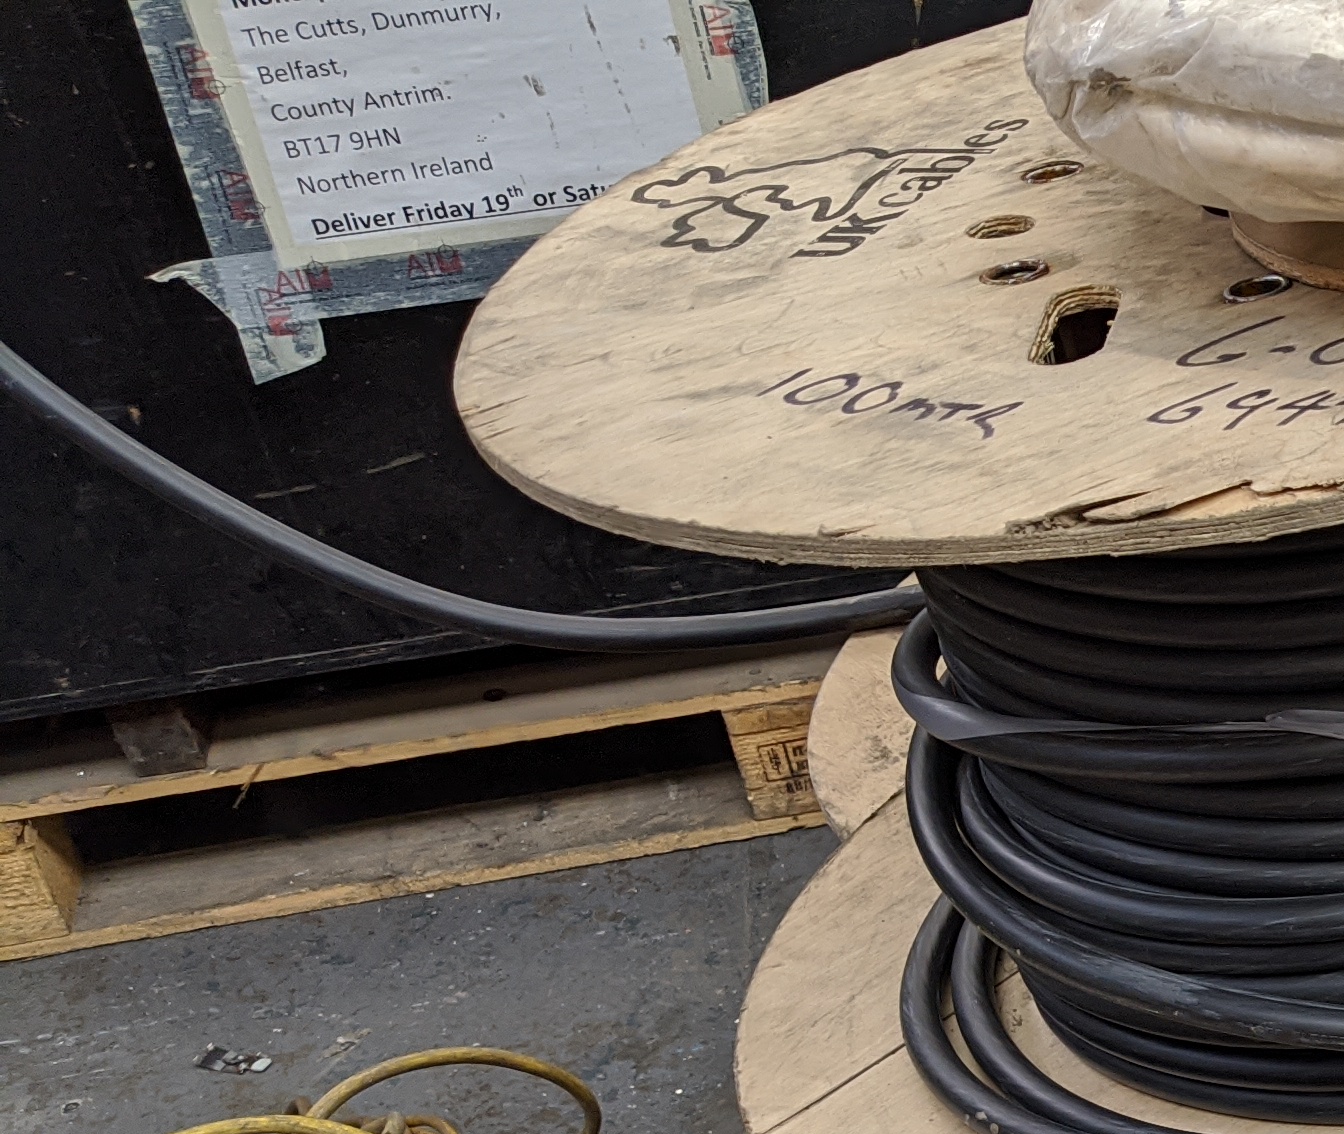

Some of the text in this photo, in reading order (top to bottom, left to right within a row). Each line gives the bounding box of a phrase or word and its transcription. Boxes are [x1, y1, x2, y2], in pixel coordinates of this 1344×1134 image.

[241, 3, 501, 47] The Cutts, Dunmurry,
[257, 57, 348, 85] Belfast,
[271, 85, 452, 123] County Antrim.
[283, 127, 402, 160] BT17 9HN
[297, 151, 493, 196] Northern Ireland
[311, 208, 396, 236] Deliver
[402, 199, 474, 225] Friday
[532, 190, 556, 207] or
